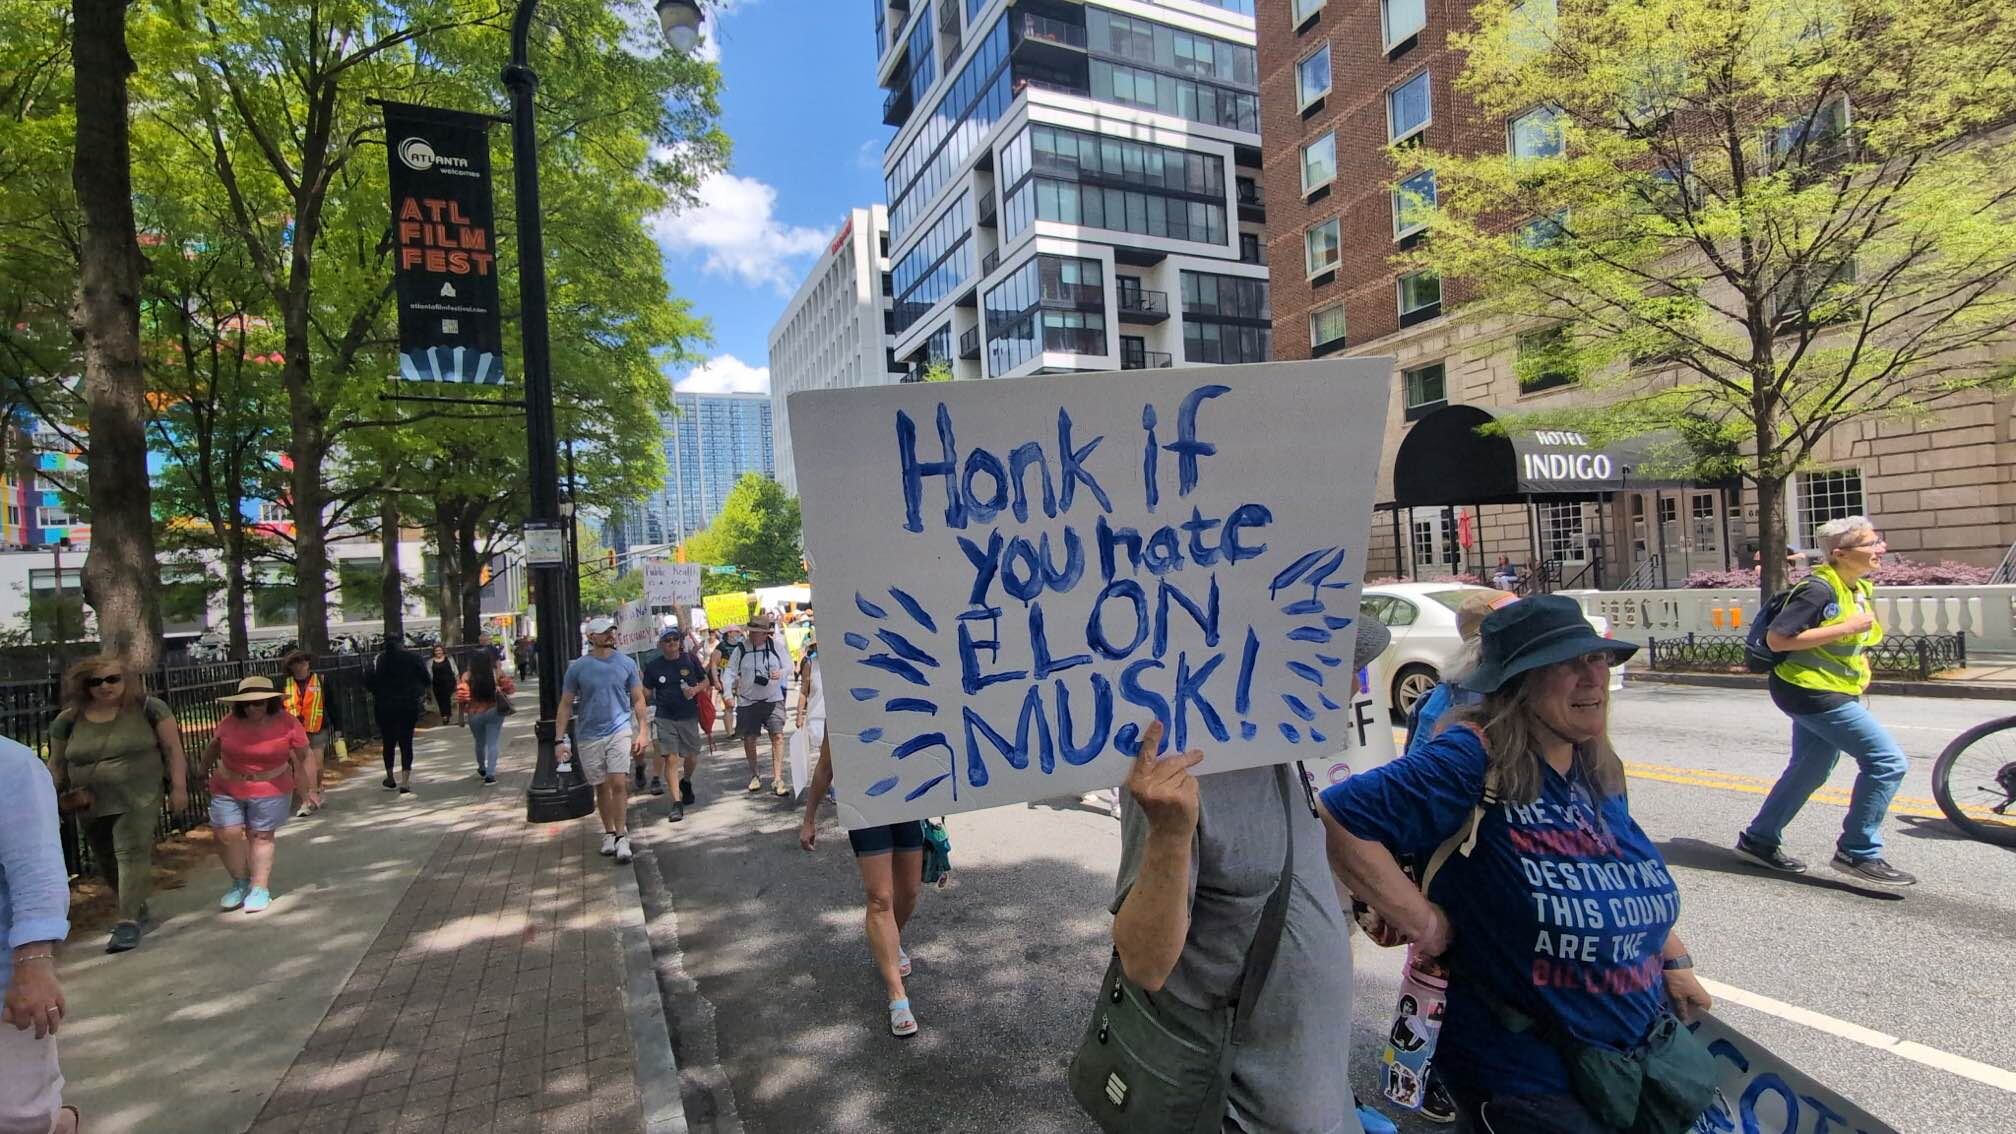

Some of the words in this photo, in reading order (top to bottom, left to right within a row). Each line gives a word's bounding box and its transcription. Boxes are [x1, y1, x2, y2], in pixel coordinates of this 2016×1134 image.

[411, 153, 468, 168] ATLANTA
[440, 168, 480, 178] welcomes
[401, 196, 471, 225] ATL
[401, 222, 486, 250] FILM
[402, 247, 493, 276] FEST
[1535, 430, 1588, 446] HOTEL
[896, 402, 1112, 533] Honk
[1143, 384, 1232, 512] if
[1524, 453, 1612, 480] INDIGO
[1096, 503, 1273, 584] hate
[955, 572, 1220, 696] ELON
[963, 624, 1260, 788] MUSK!
[1504, 799, 1554, 825] THE
[1531, 892, 1604, 929] THIS
[1534, 930, 1600, 962] ARE
[1612, 932, 1648, 963] THE
